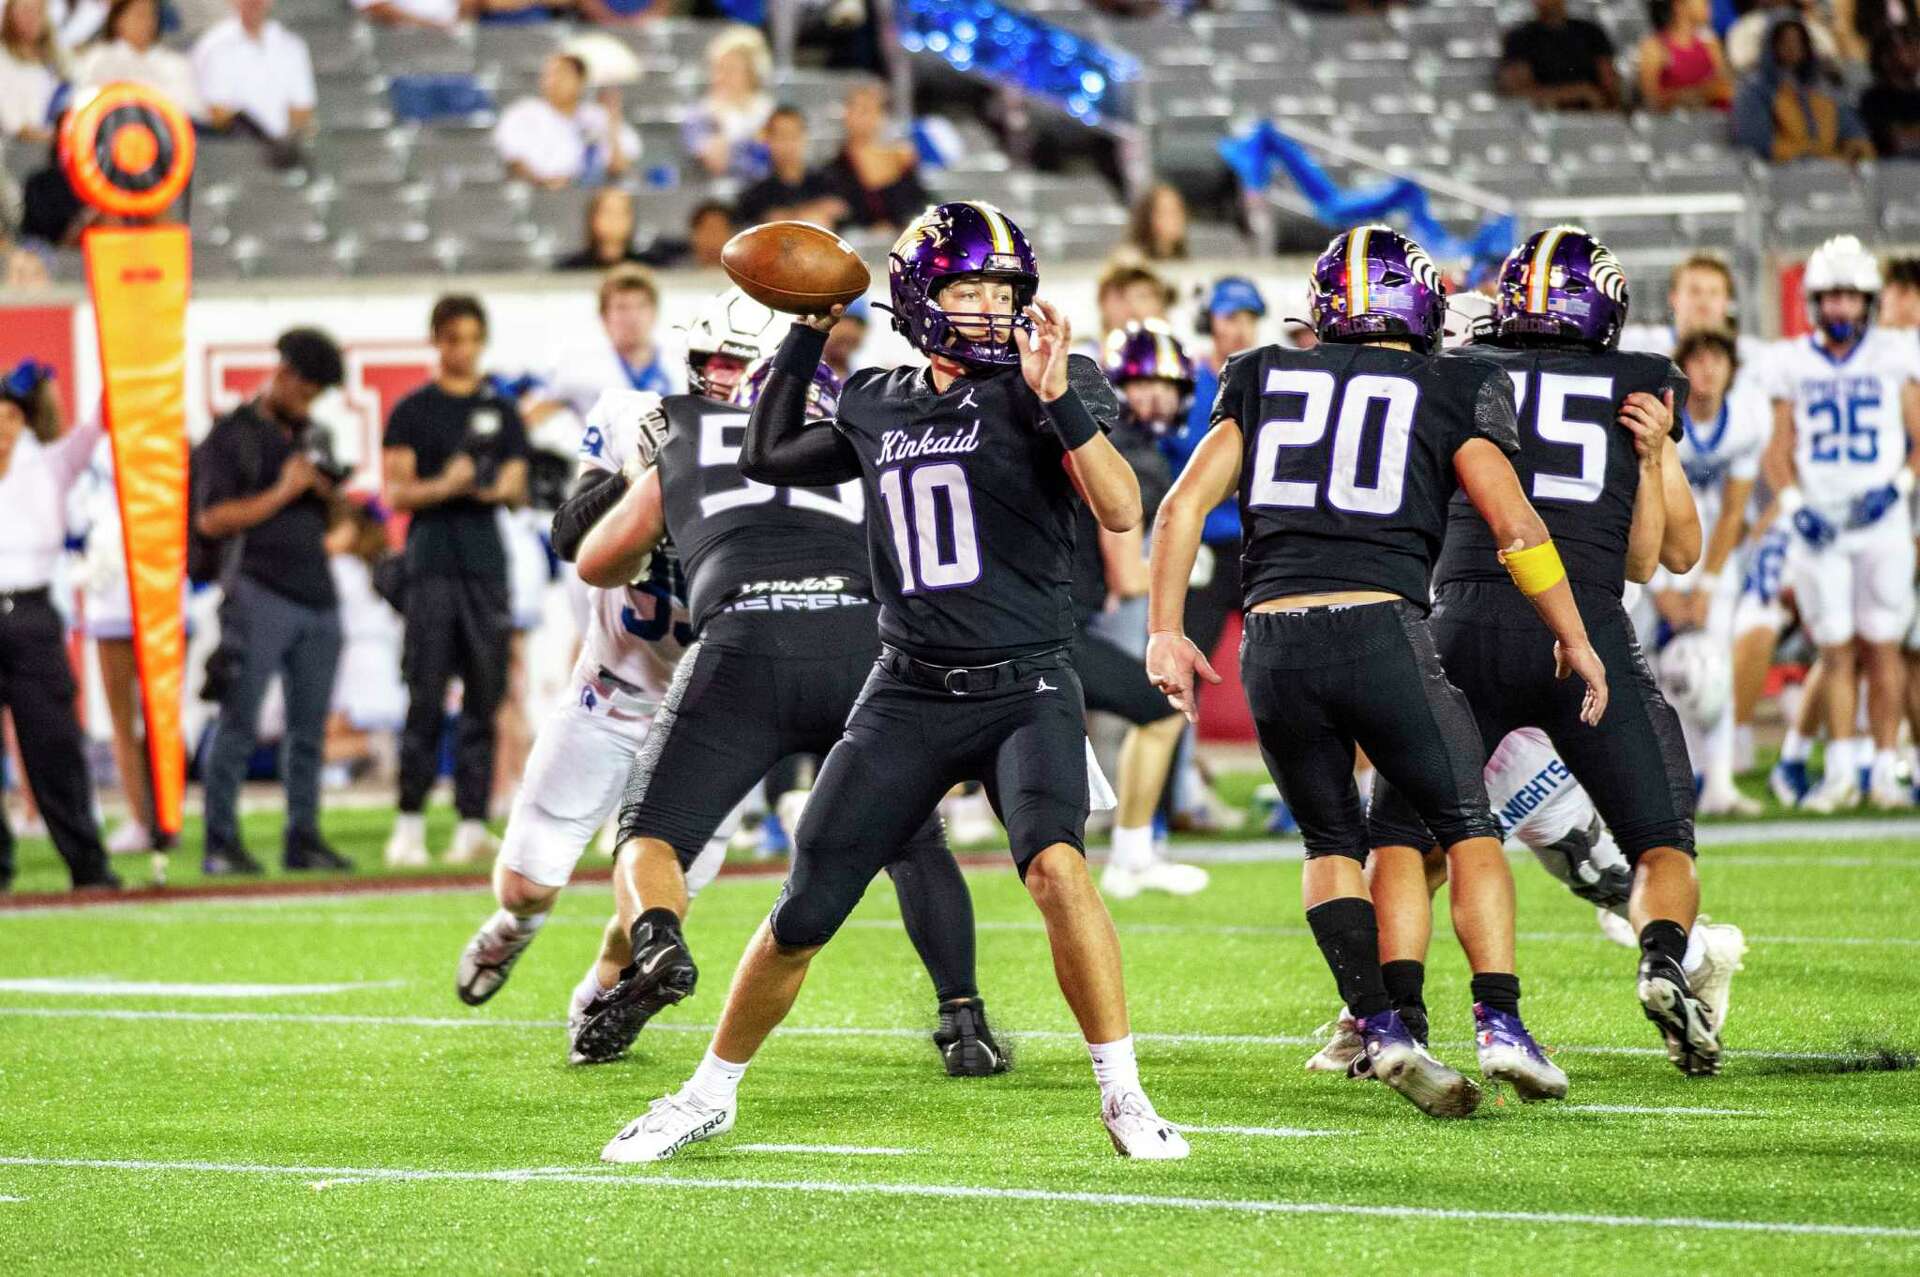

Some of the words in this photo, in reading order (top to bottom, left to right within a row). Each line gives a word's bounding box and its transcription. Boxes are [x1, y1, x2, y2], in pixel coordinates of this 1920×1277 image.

[876, 419, 980, 466] Kinkaid
[1249, 369, 1418, 515] 20
[1807, 396, 1880, 463] 25
[879, 462, 984, 593] 10
[1501, 759, 1571, 832] NIGHTS
